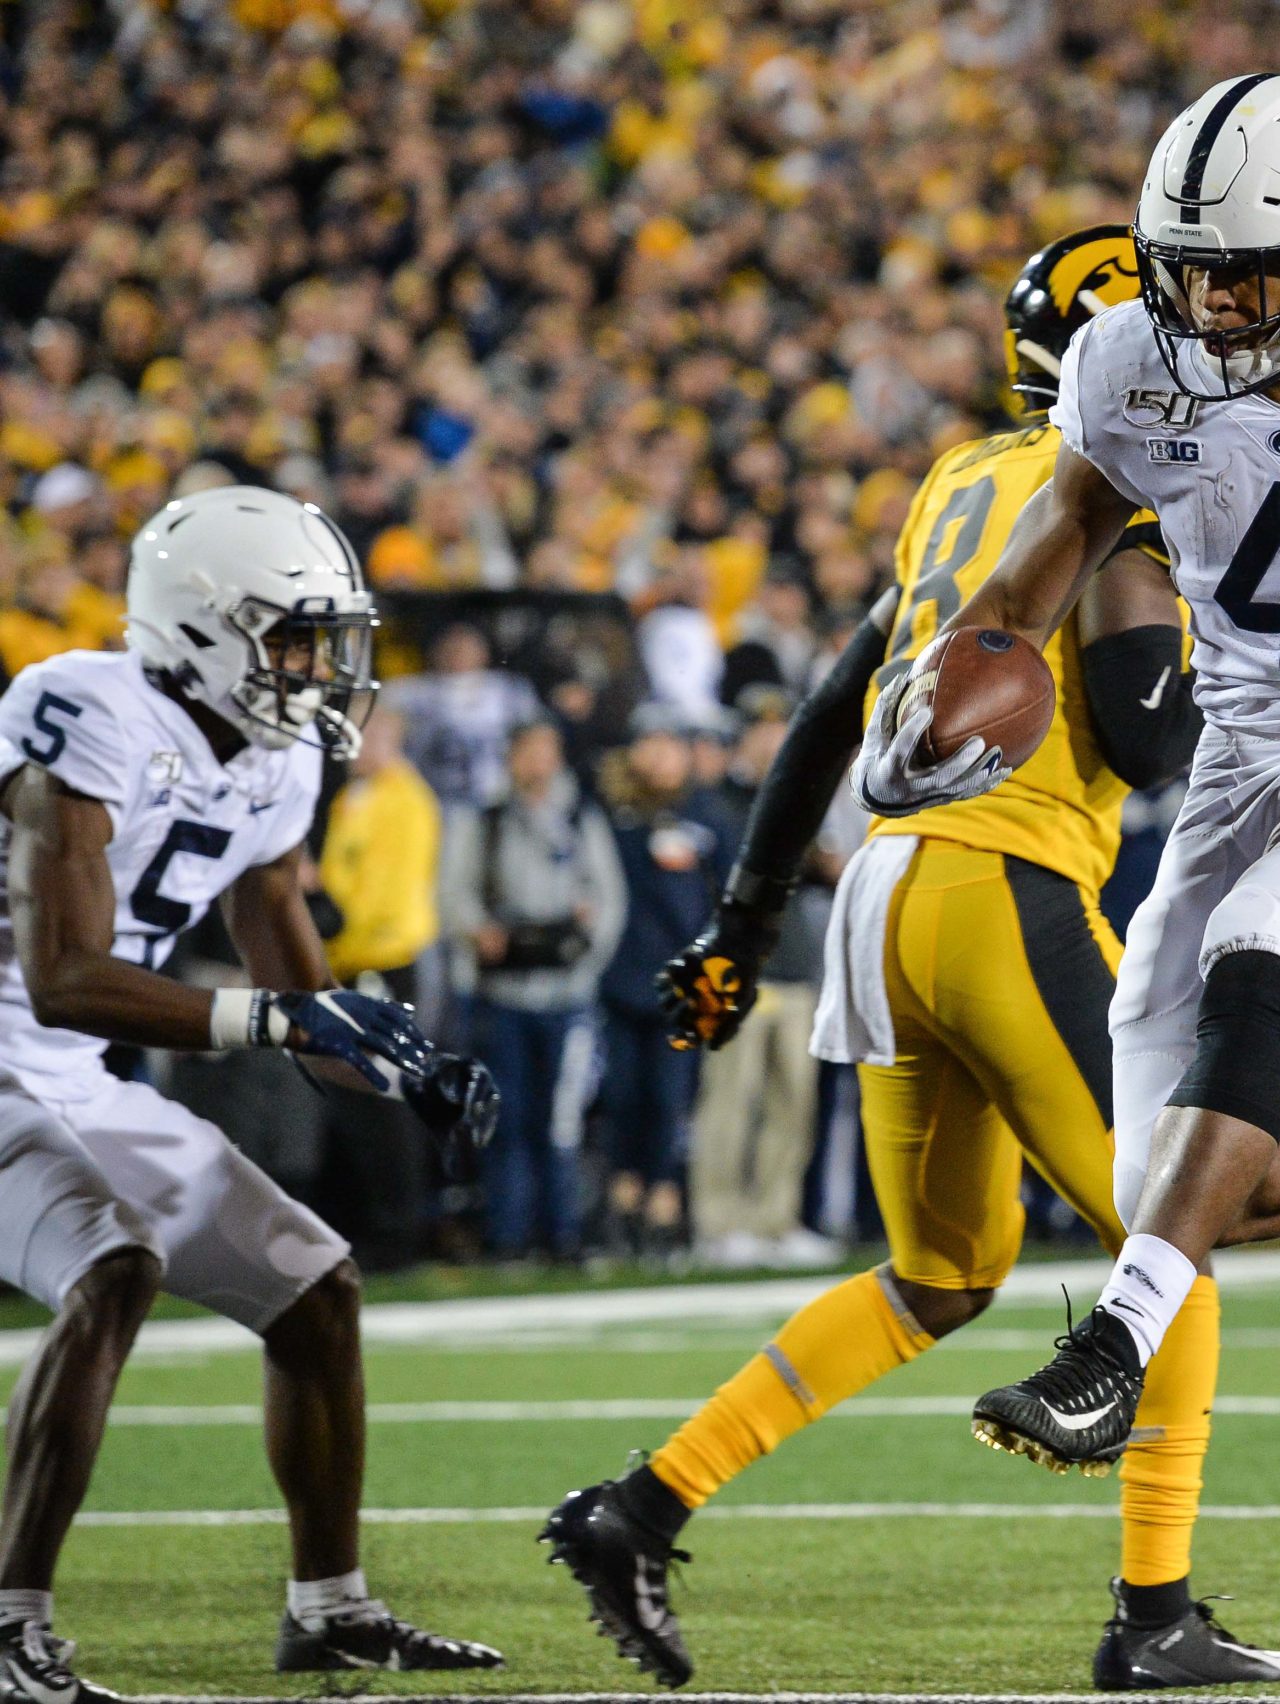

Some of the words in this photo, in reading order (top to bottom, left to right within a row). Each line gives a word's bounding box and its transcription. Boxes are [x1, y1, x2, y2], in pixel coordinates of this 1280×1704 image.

[1168, 227, 1183, 235] PENN
[1183, 229, 1203, 237] STATE
[1119, 386, 1200, 429] 150
[21, 690, 83, 766] 5
[129, 818, 234, 972] 5
